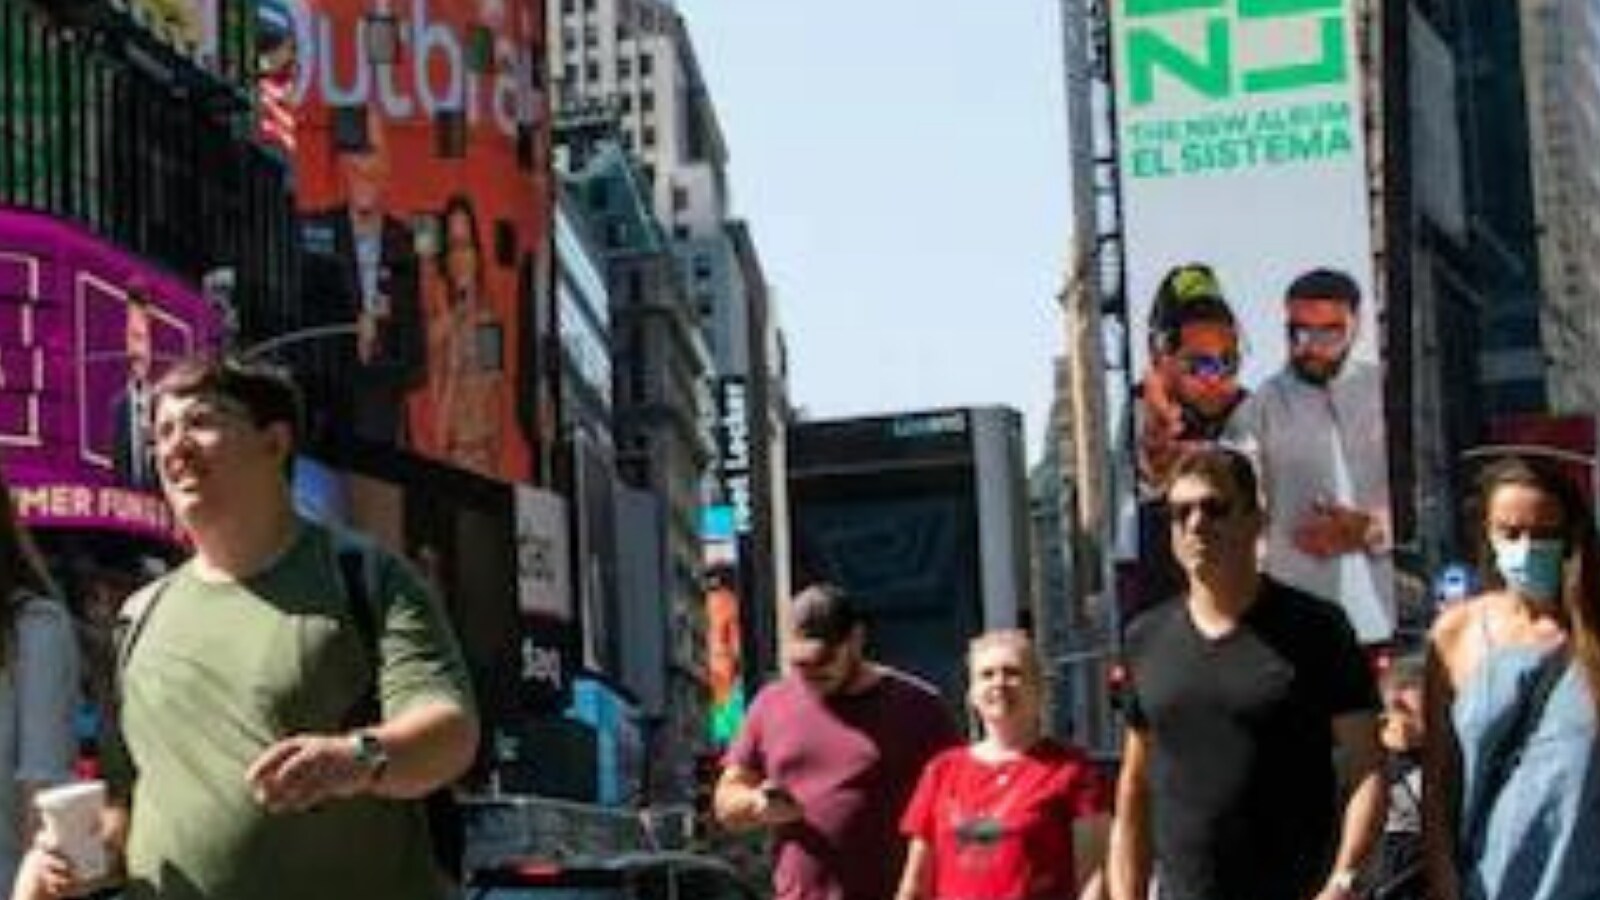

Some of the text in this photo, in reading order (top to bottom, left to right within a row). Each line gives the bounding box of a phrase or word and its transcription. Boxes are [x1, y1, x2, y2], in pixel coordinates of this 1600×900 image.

[1128, 99, 1350, 141] THE NEW ALBUM
[1133, 127, 1352, 178] EL SISTEMA
[10, 484, 93, 518] MER
